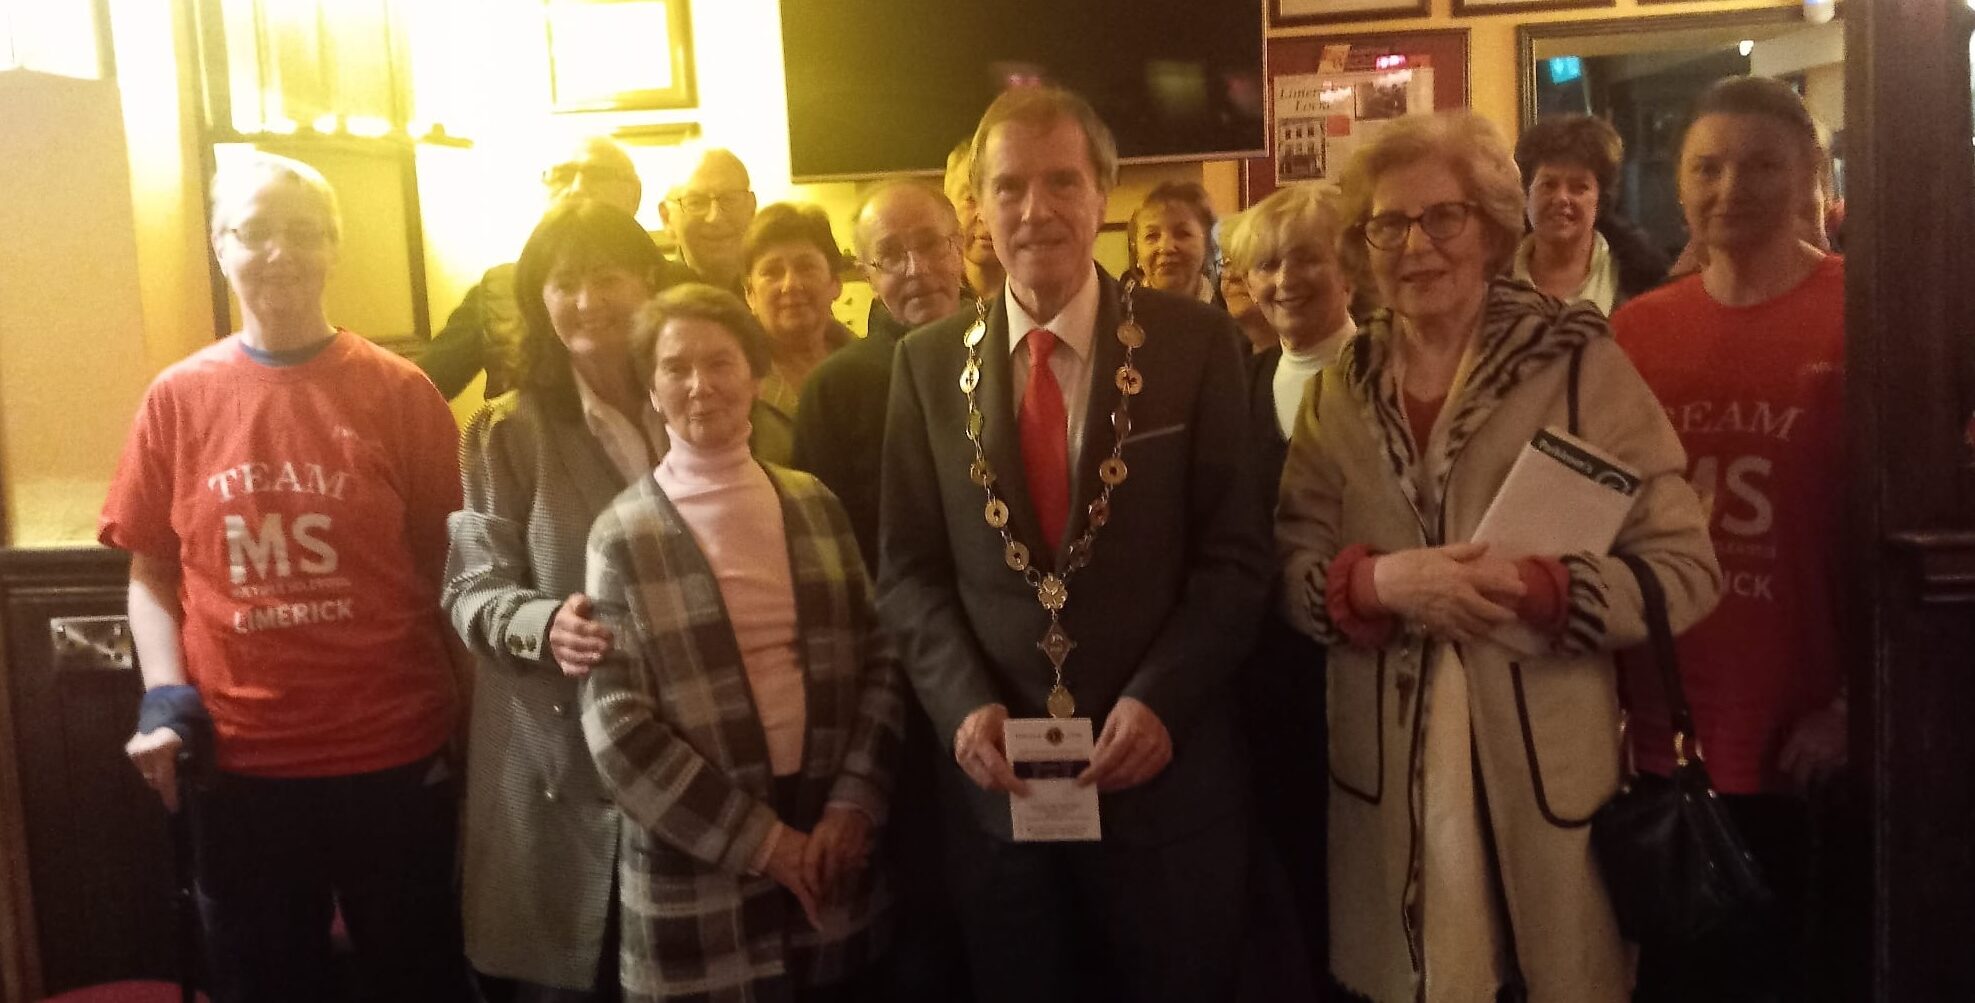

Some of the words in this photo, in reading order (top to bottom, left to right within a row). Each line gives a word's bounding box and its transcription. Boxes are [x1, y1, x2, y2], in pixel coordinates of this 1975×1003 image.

[1665, 400, 1804, 442] EAM
[207, 461, 351, 503] TEAM
[224, 512, 339, 585] MS
[232, 600, 354, 635] LIMERICK
